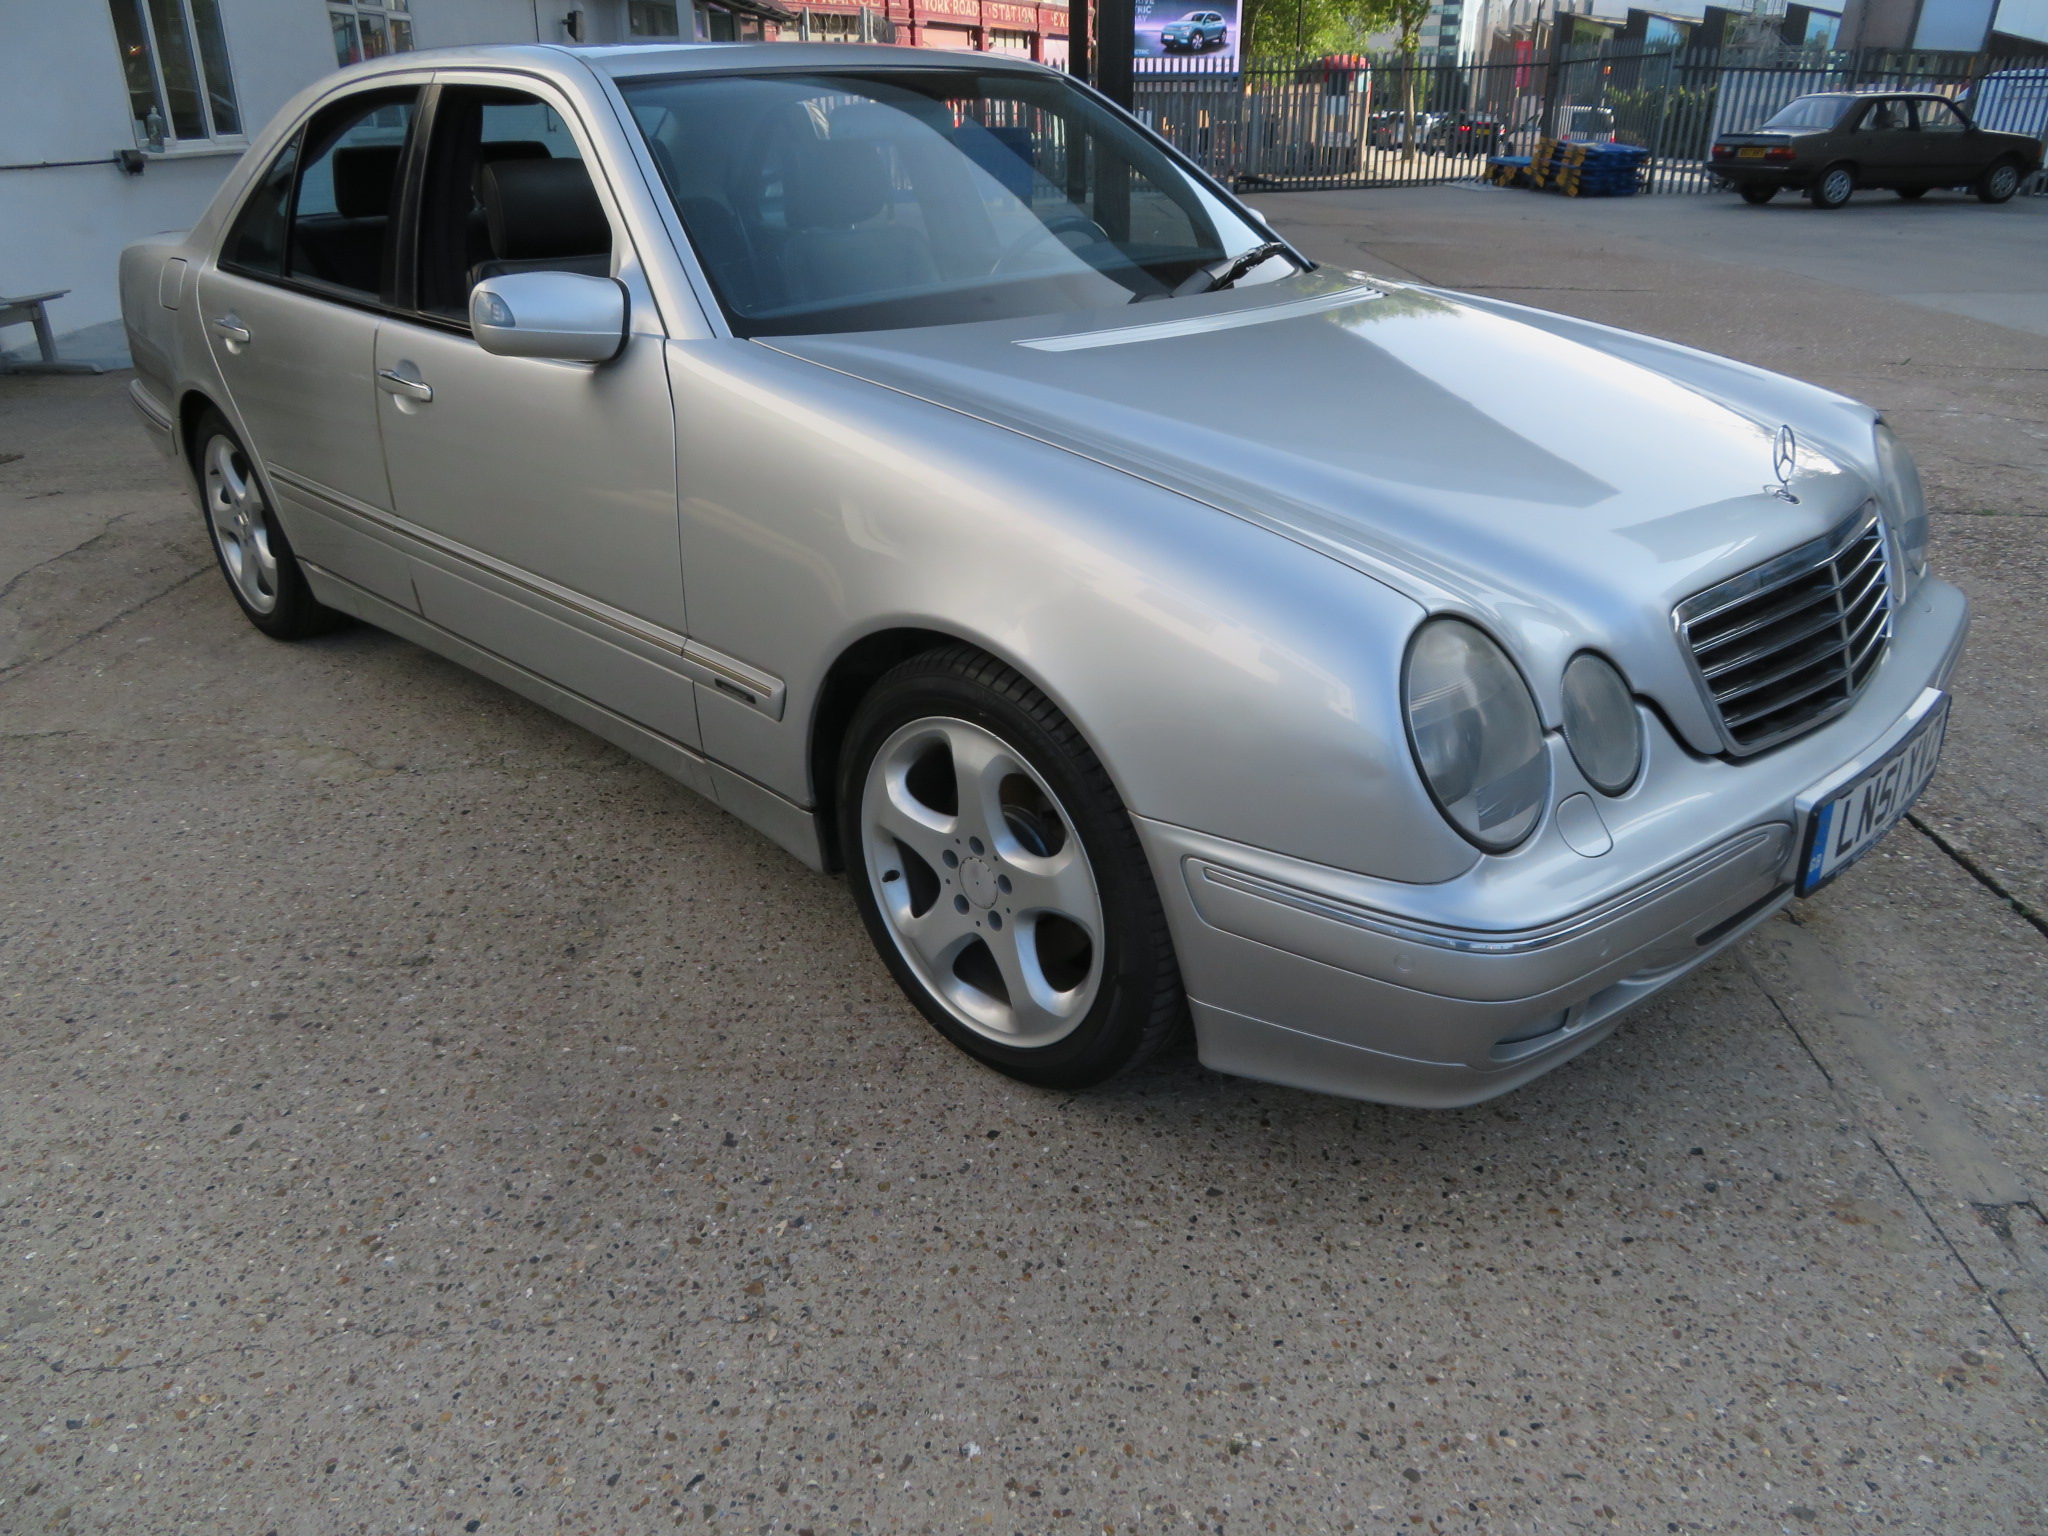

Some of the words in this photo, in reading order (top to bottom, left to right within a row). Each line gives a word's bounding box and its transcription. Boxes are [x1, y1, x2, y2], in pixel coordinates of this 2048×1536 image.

[922, 0, 950, 14] YORK
[953, 0, 978, 17] ROAD
[991, 3, 1034, 23] STATION
[1053, 11, 1069, 28] EXI
